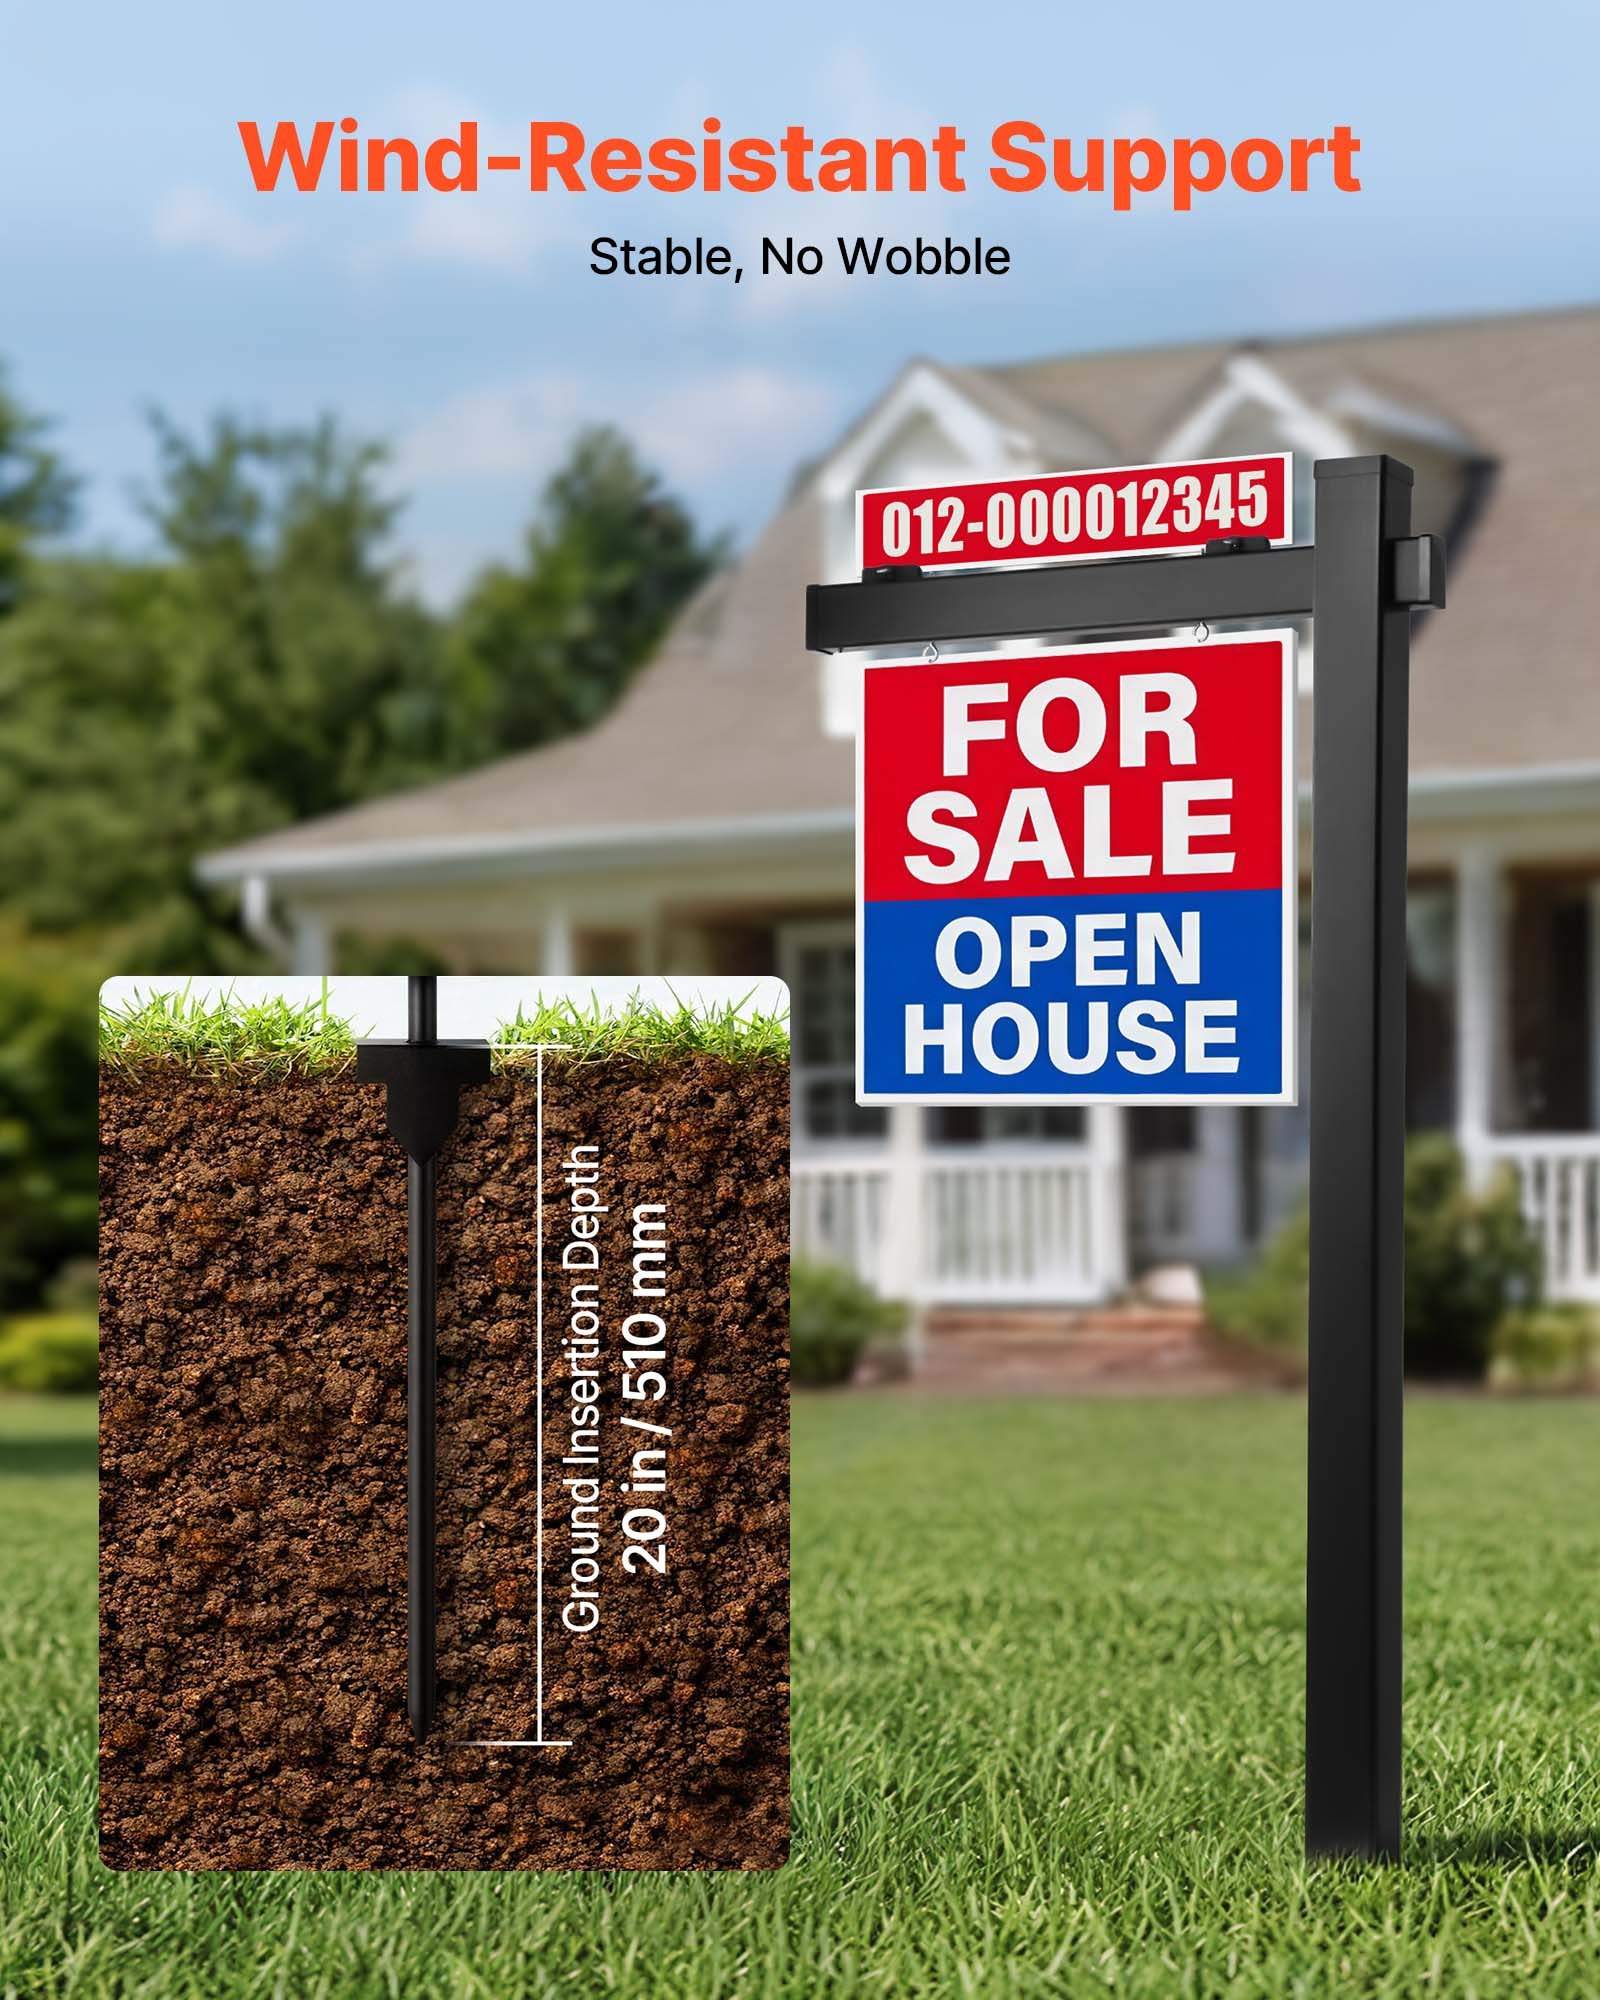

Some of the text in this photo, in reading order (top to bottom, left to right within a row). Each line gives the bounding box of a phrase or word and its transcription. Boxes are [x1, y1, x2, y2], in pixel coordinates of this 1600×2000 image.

[882, 469, 1268, 558] 012-000012345
[943, 672, 1198, 777] FOR
[903, 778, 1236, 885] SALE
[935, 911, 1201, 990] OPEN
[905, 999, 1240, 1075] HOUSE
